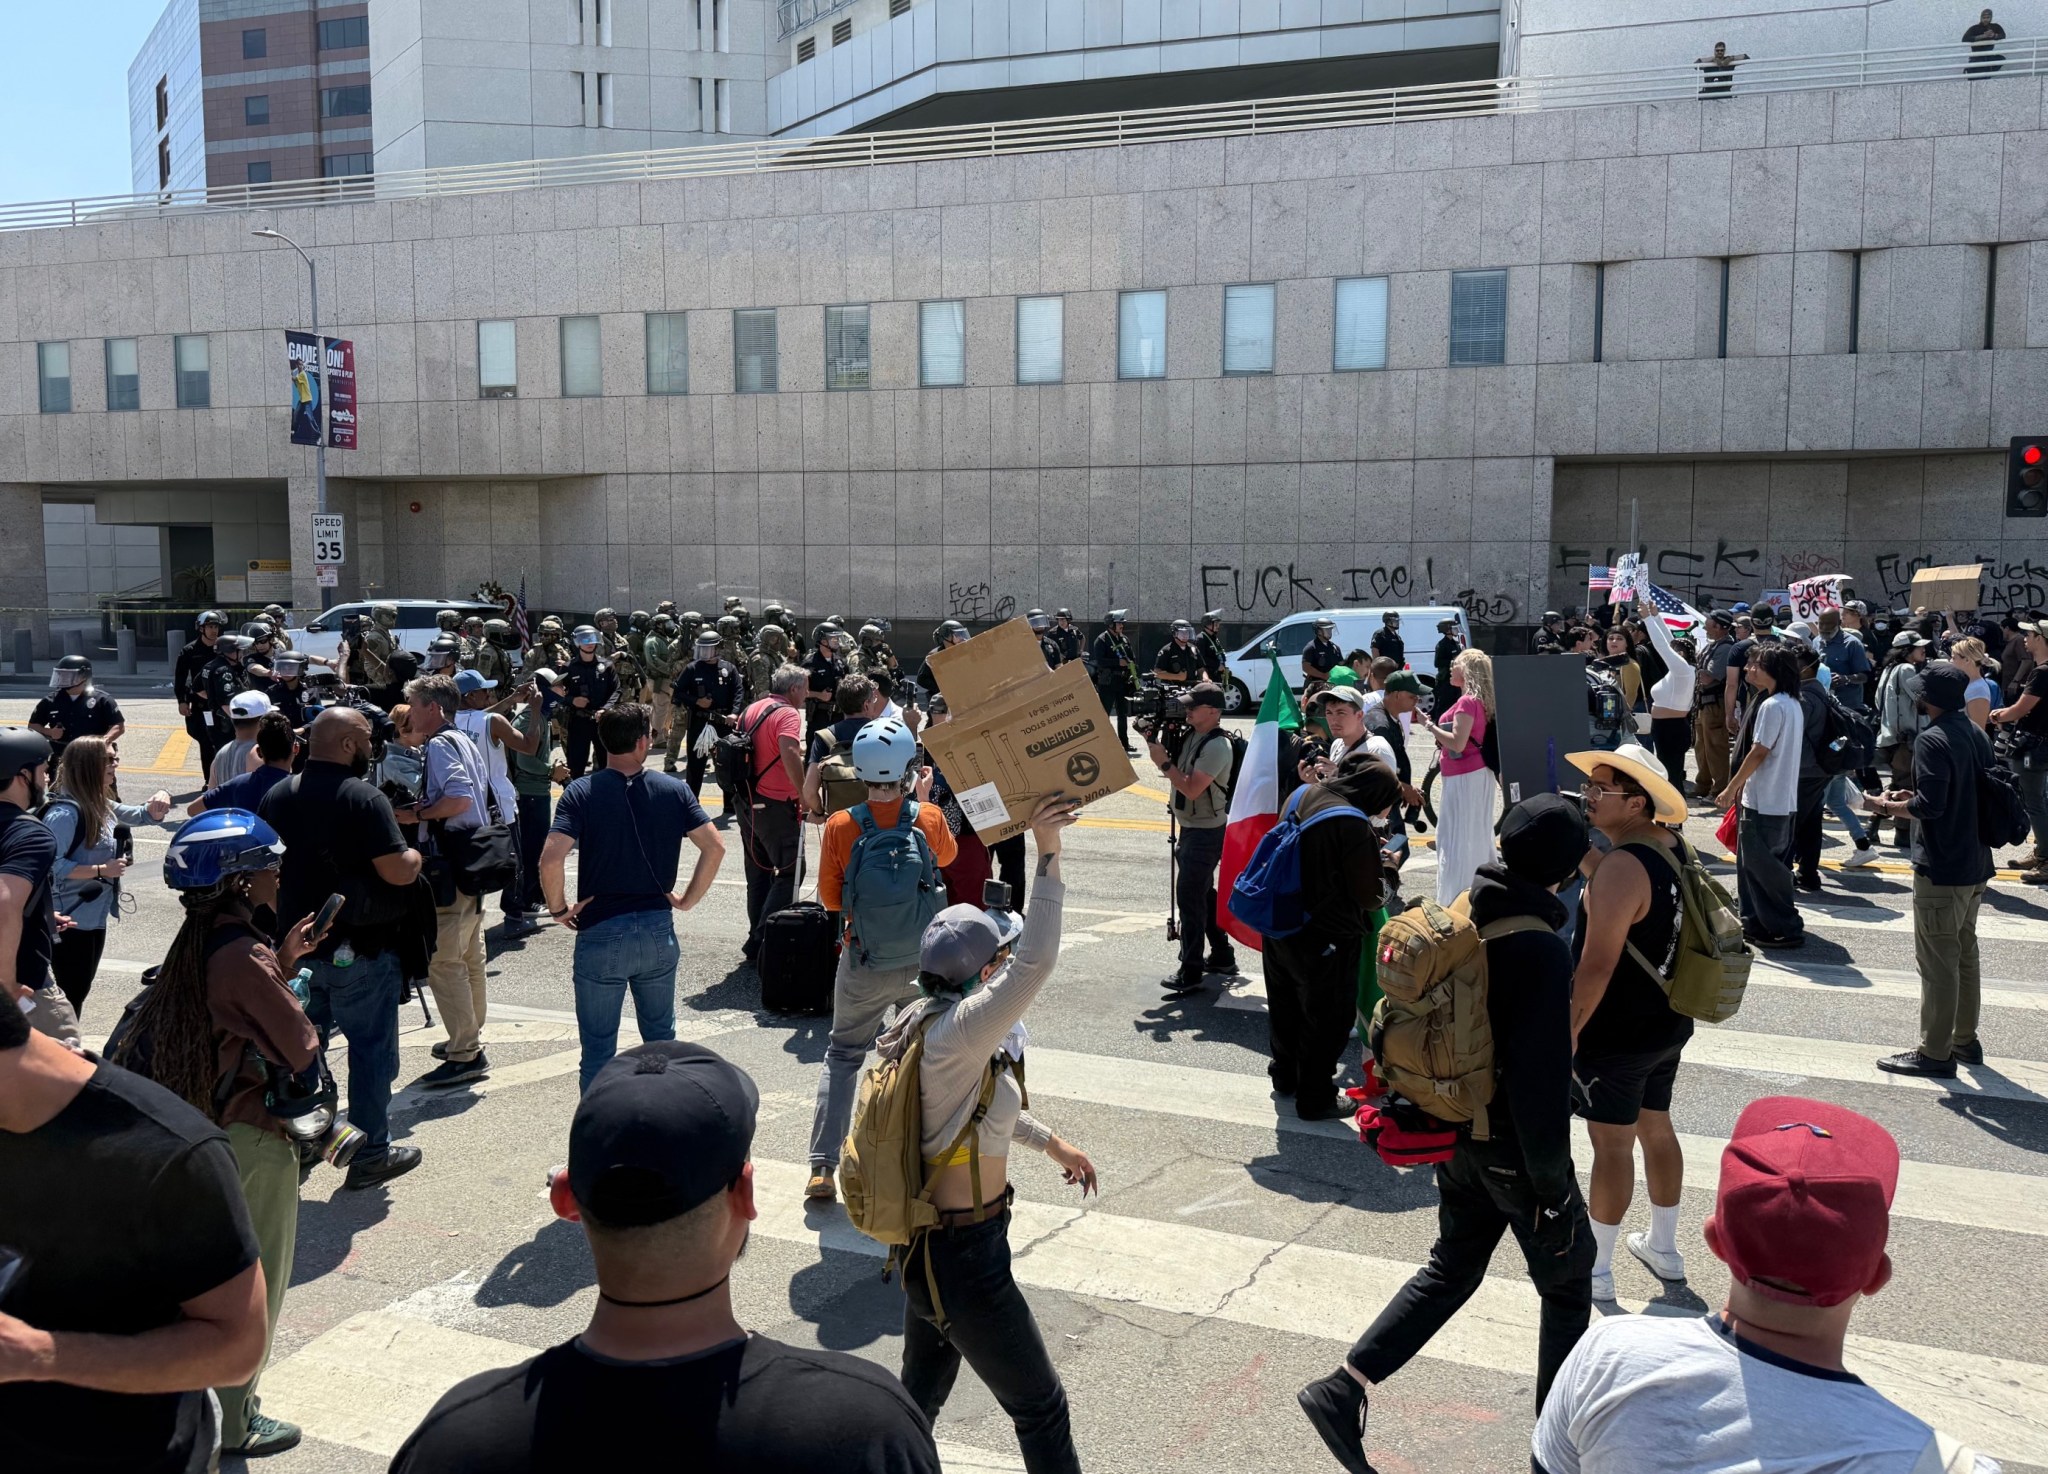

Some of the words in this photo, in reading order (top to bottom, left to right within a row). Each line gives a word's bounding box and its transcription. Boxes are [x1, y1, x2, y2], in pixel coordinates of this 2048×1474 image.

[288, 341, 317, 364] GAME
[326, 348, 344, 369] ON!
[314, 518, 342, 527] SPEED
[317, 529, 339, 538] LIMIT
[317, 541, 342, 560] 35
[1200, 563, 1326, 612] FUCK
[1977, 583, 2046, 609] LAPD
[949, 597, 987, 621] ICE
[1046, 705, 1080, 724] SHOWER
[1020, 720, 1047, 735] STOOL
[1031, 720, 1089, 752] SOUHEILO
[1084, 786, 1111, 803] YOUR
[999, 820, 1027, 837] CARE!
